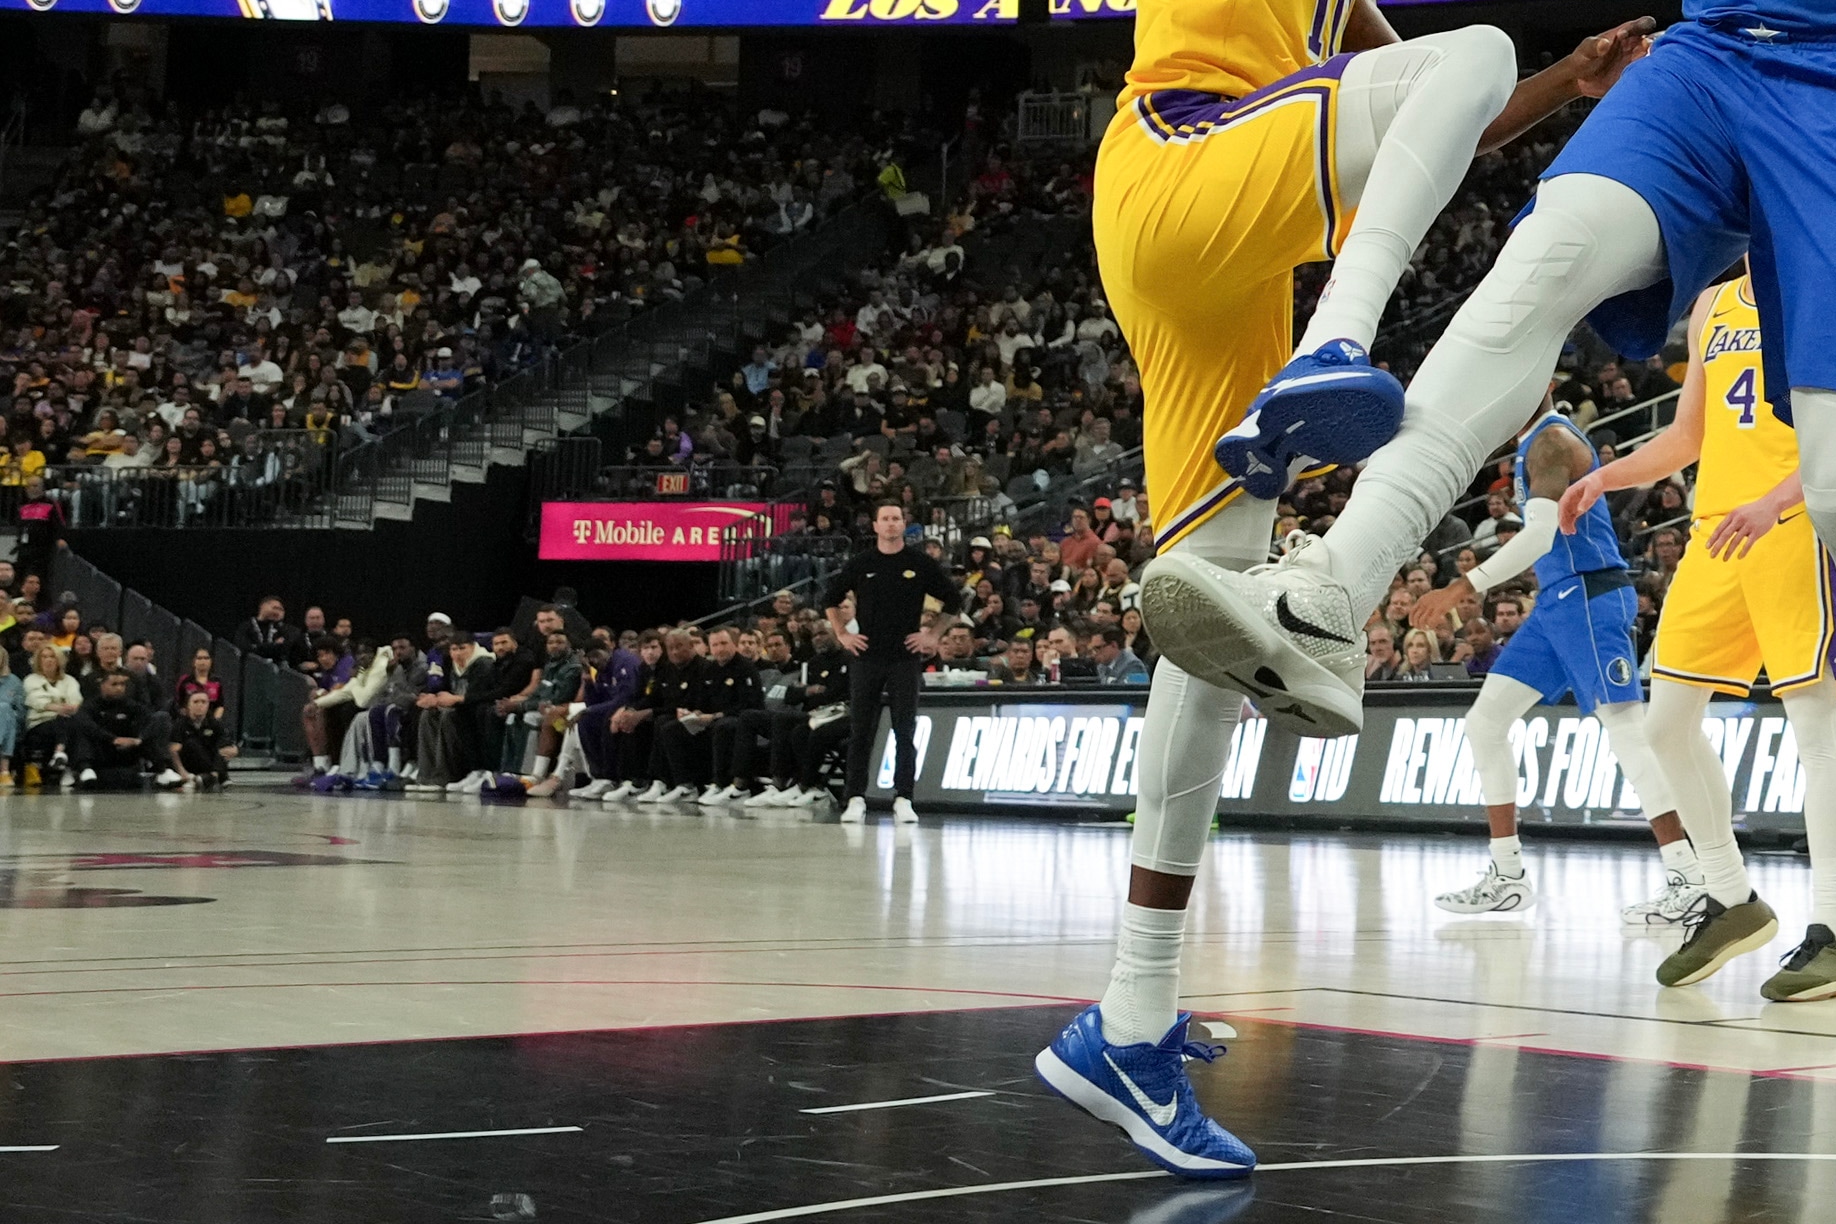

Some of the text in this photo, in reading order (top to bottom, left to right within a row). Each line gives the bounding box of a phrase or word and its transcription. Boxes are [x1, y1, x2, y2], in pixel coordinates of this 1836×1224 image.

[1703, 324, 1763, 364] LAKE
[1725, 368, 1756, 425] 4
[663, 475, 684, 492] EXIT
[941, 716, 1066, 793] REWARDS
[1057, 717, 1120, 795] FOR
